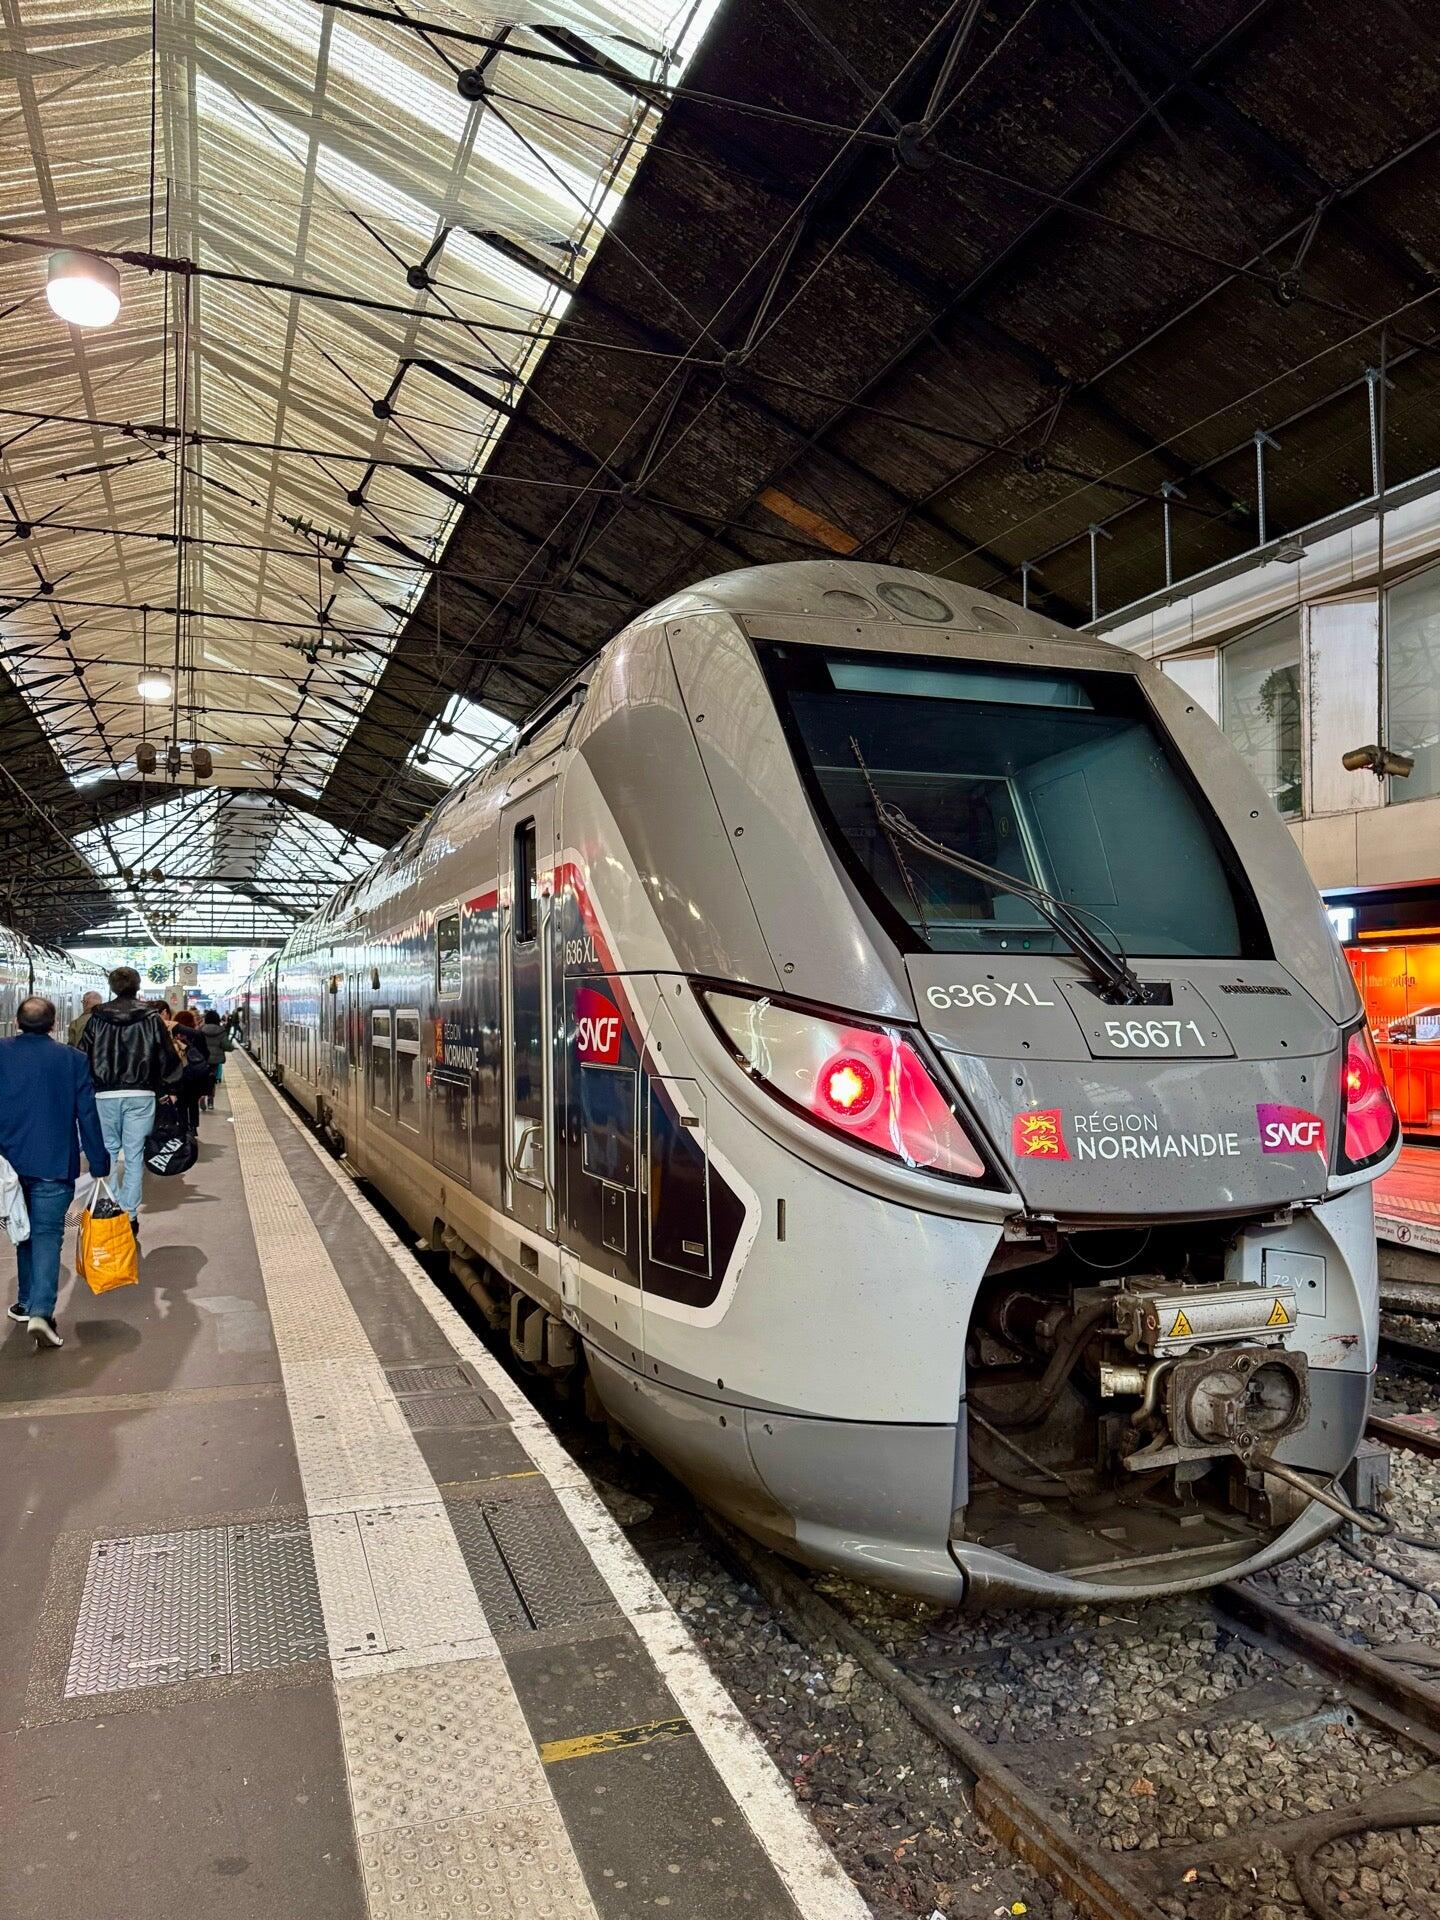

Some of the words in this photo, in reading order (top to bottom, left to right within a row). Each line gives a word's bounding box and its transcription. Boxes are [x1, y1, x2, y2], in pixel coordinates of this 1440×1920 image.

[566, 936, 599, 965] 636XL
[926, 983, 1055, 1009] 636XL
[578, 1017, 619, 1053] SNCF
[1104, 1020, 1206, 1049] 56671
[445, 1044, 479, 1071] NORMANDIE
[1074, 1111, 1158, 1133] RÉGION
[1264, 1121, 1321, 1147] SNCF
[1076, 1133, 1241, 1160] NORMANDIE
[1272, 1274, 1290, 1286] 72
[1295, 1276, 1304, 1288] V
